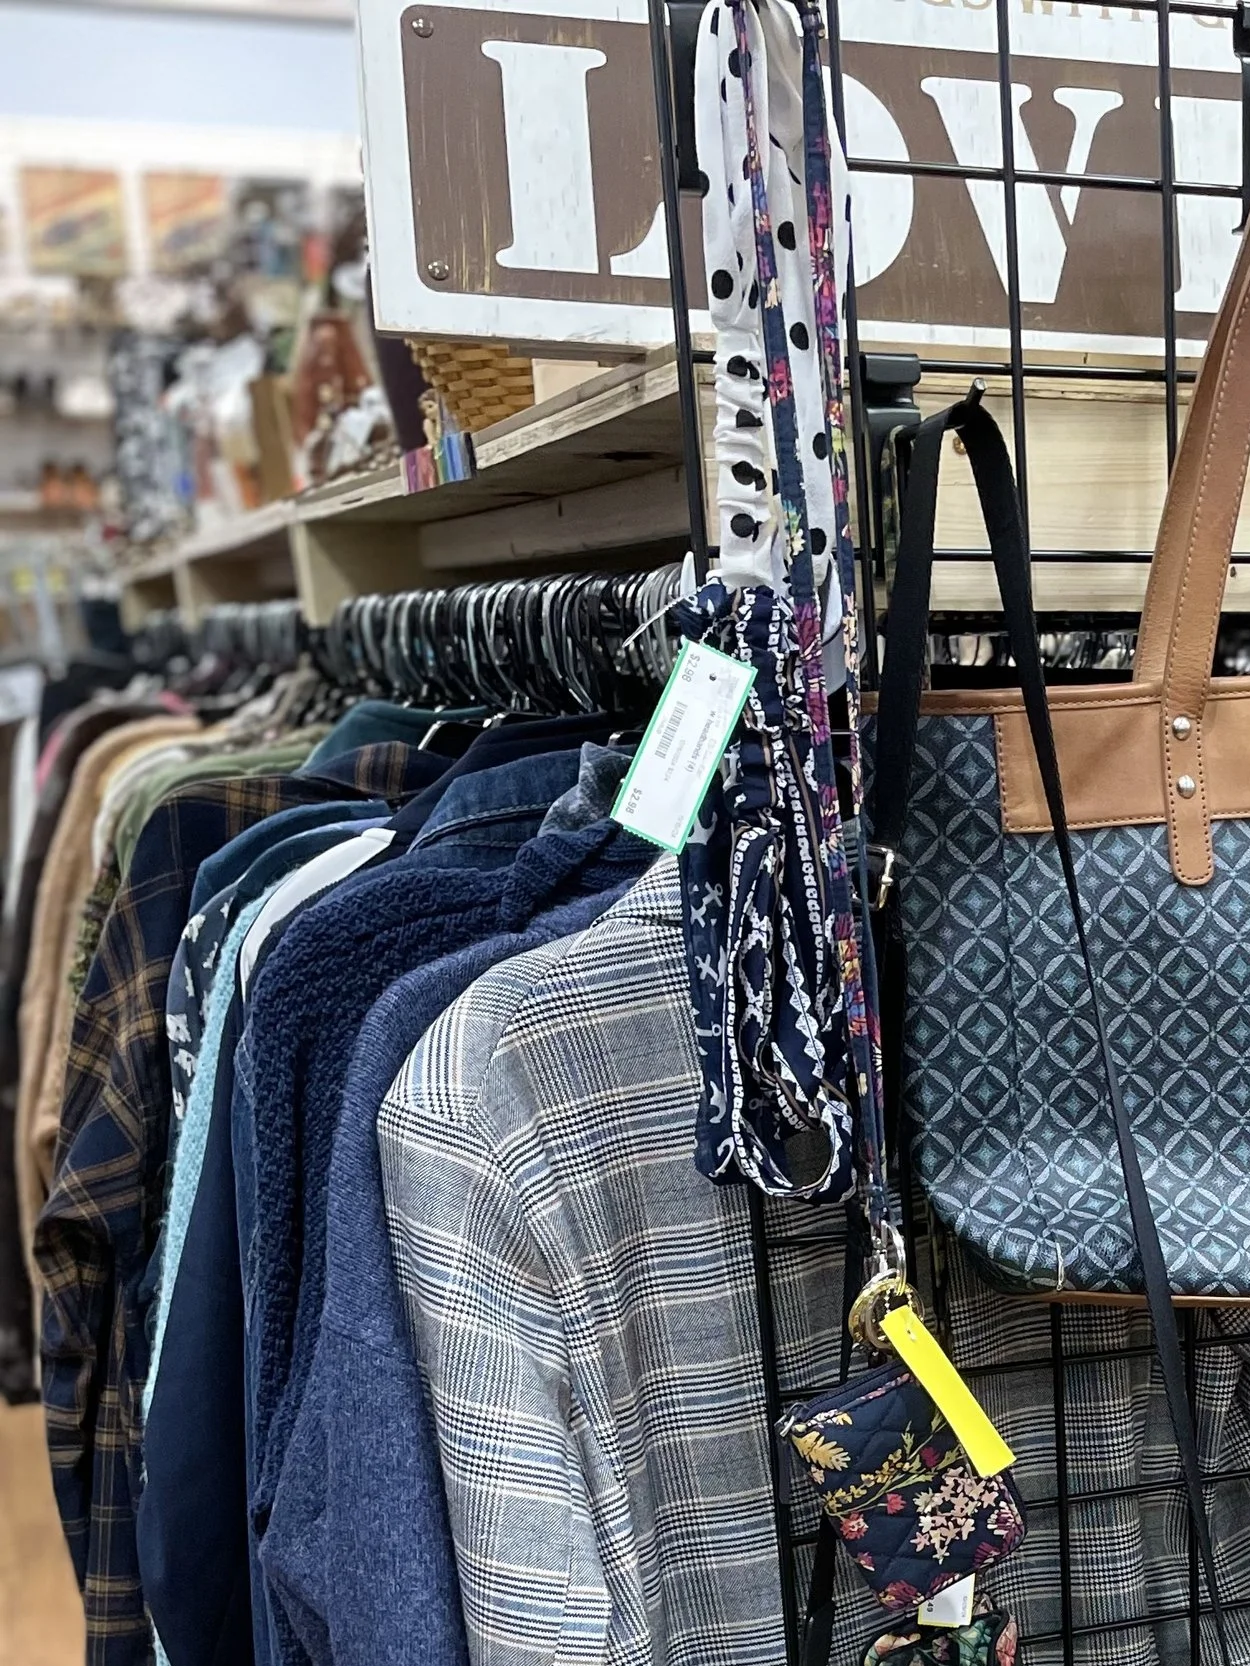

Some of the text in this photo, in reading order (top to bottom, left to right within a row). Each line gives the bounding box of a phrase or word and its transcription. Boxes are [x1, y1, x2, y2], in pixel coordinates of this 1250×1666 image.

[681, 653, 701, 683] $2.98
[691, 718, 715, 761] headbands
[625, 787, 643, 815] $2.98
